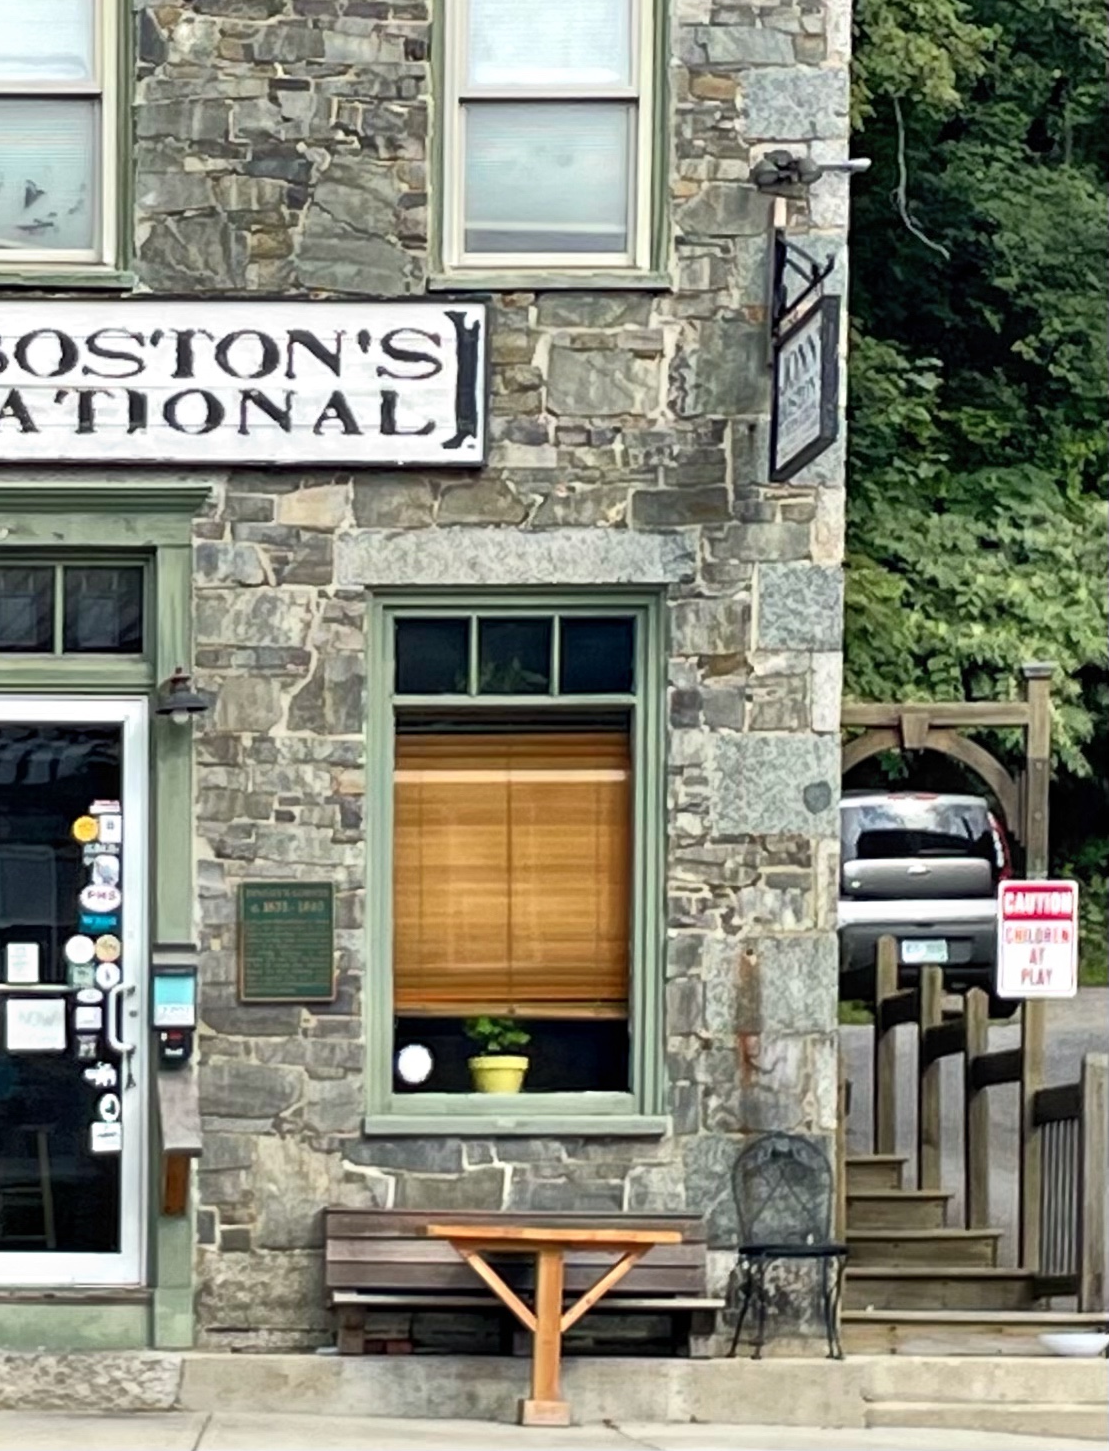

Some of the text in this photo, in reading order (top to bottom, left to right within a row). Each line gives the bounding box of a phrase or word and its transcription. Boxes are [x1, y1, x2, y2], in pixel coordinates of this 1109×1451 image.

[1004, 891, 1073, 914] CAUTION
[1005, 927, 1070, 944] CHILDREN
[1029, 948, 1046, 965] AT
[1021, 969, 1052, 986] PLAY
